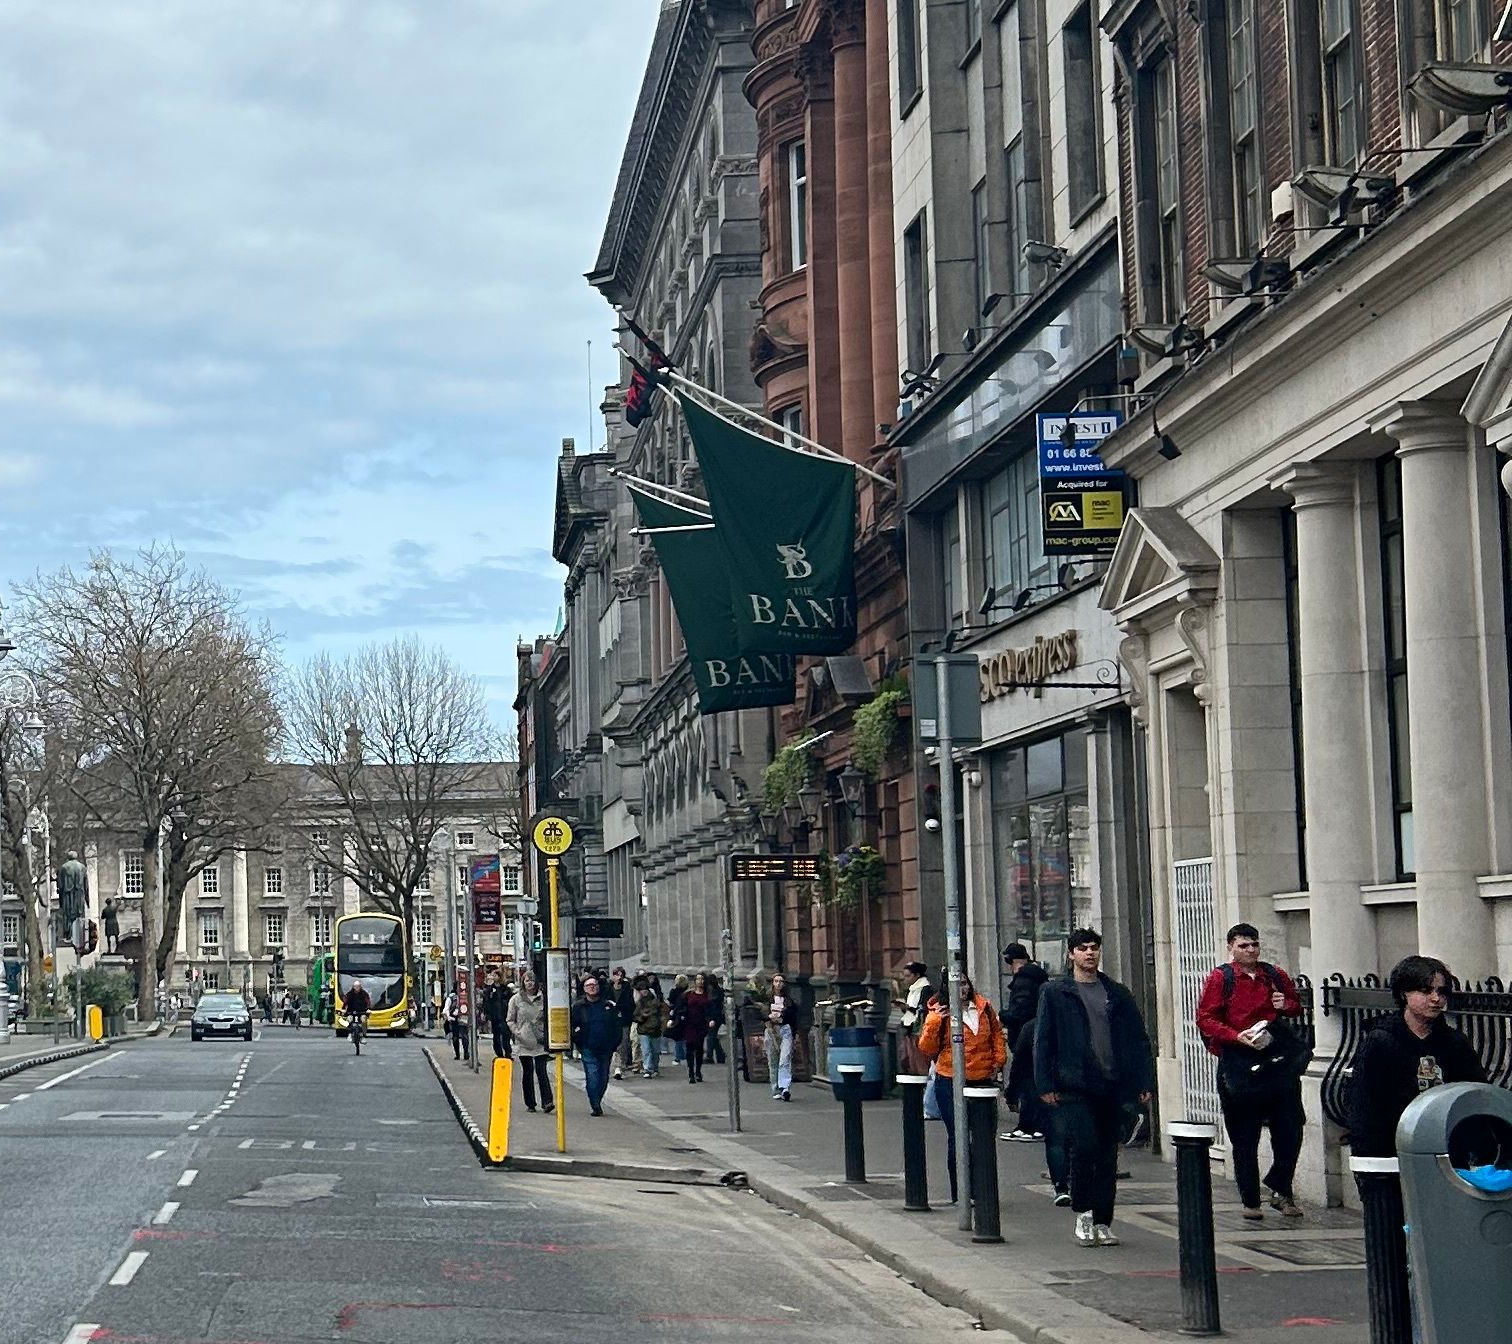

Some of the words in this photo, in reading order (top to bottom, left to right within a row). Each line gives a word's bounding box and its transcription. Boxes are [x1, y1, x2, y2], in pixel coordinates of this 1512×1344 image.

[1050, 423, 1097, 435] INEST
[1047, 449, 1060, 459] 01
[1063, 449, 1077, 459] 66
[1045, 463, 1105, 472] www.invest
[1056, 480, 1094, 489] Acquired
